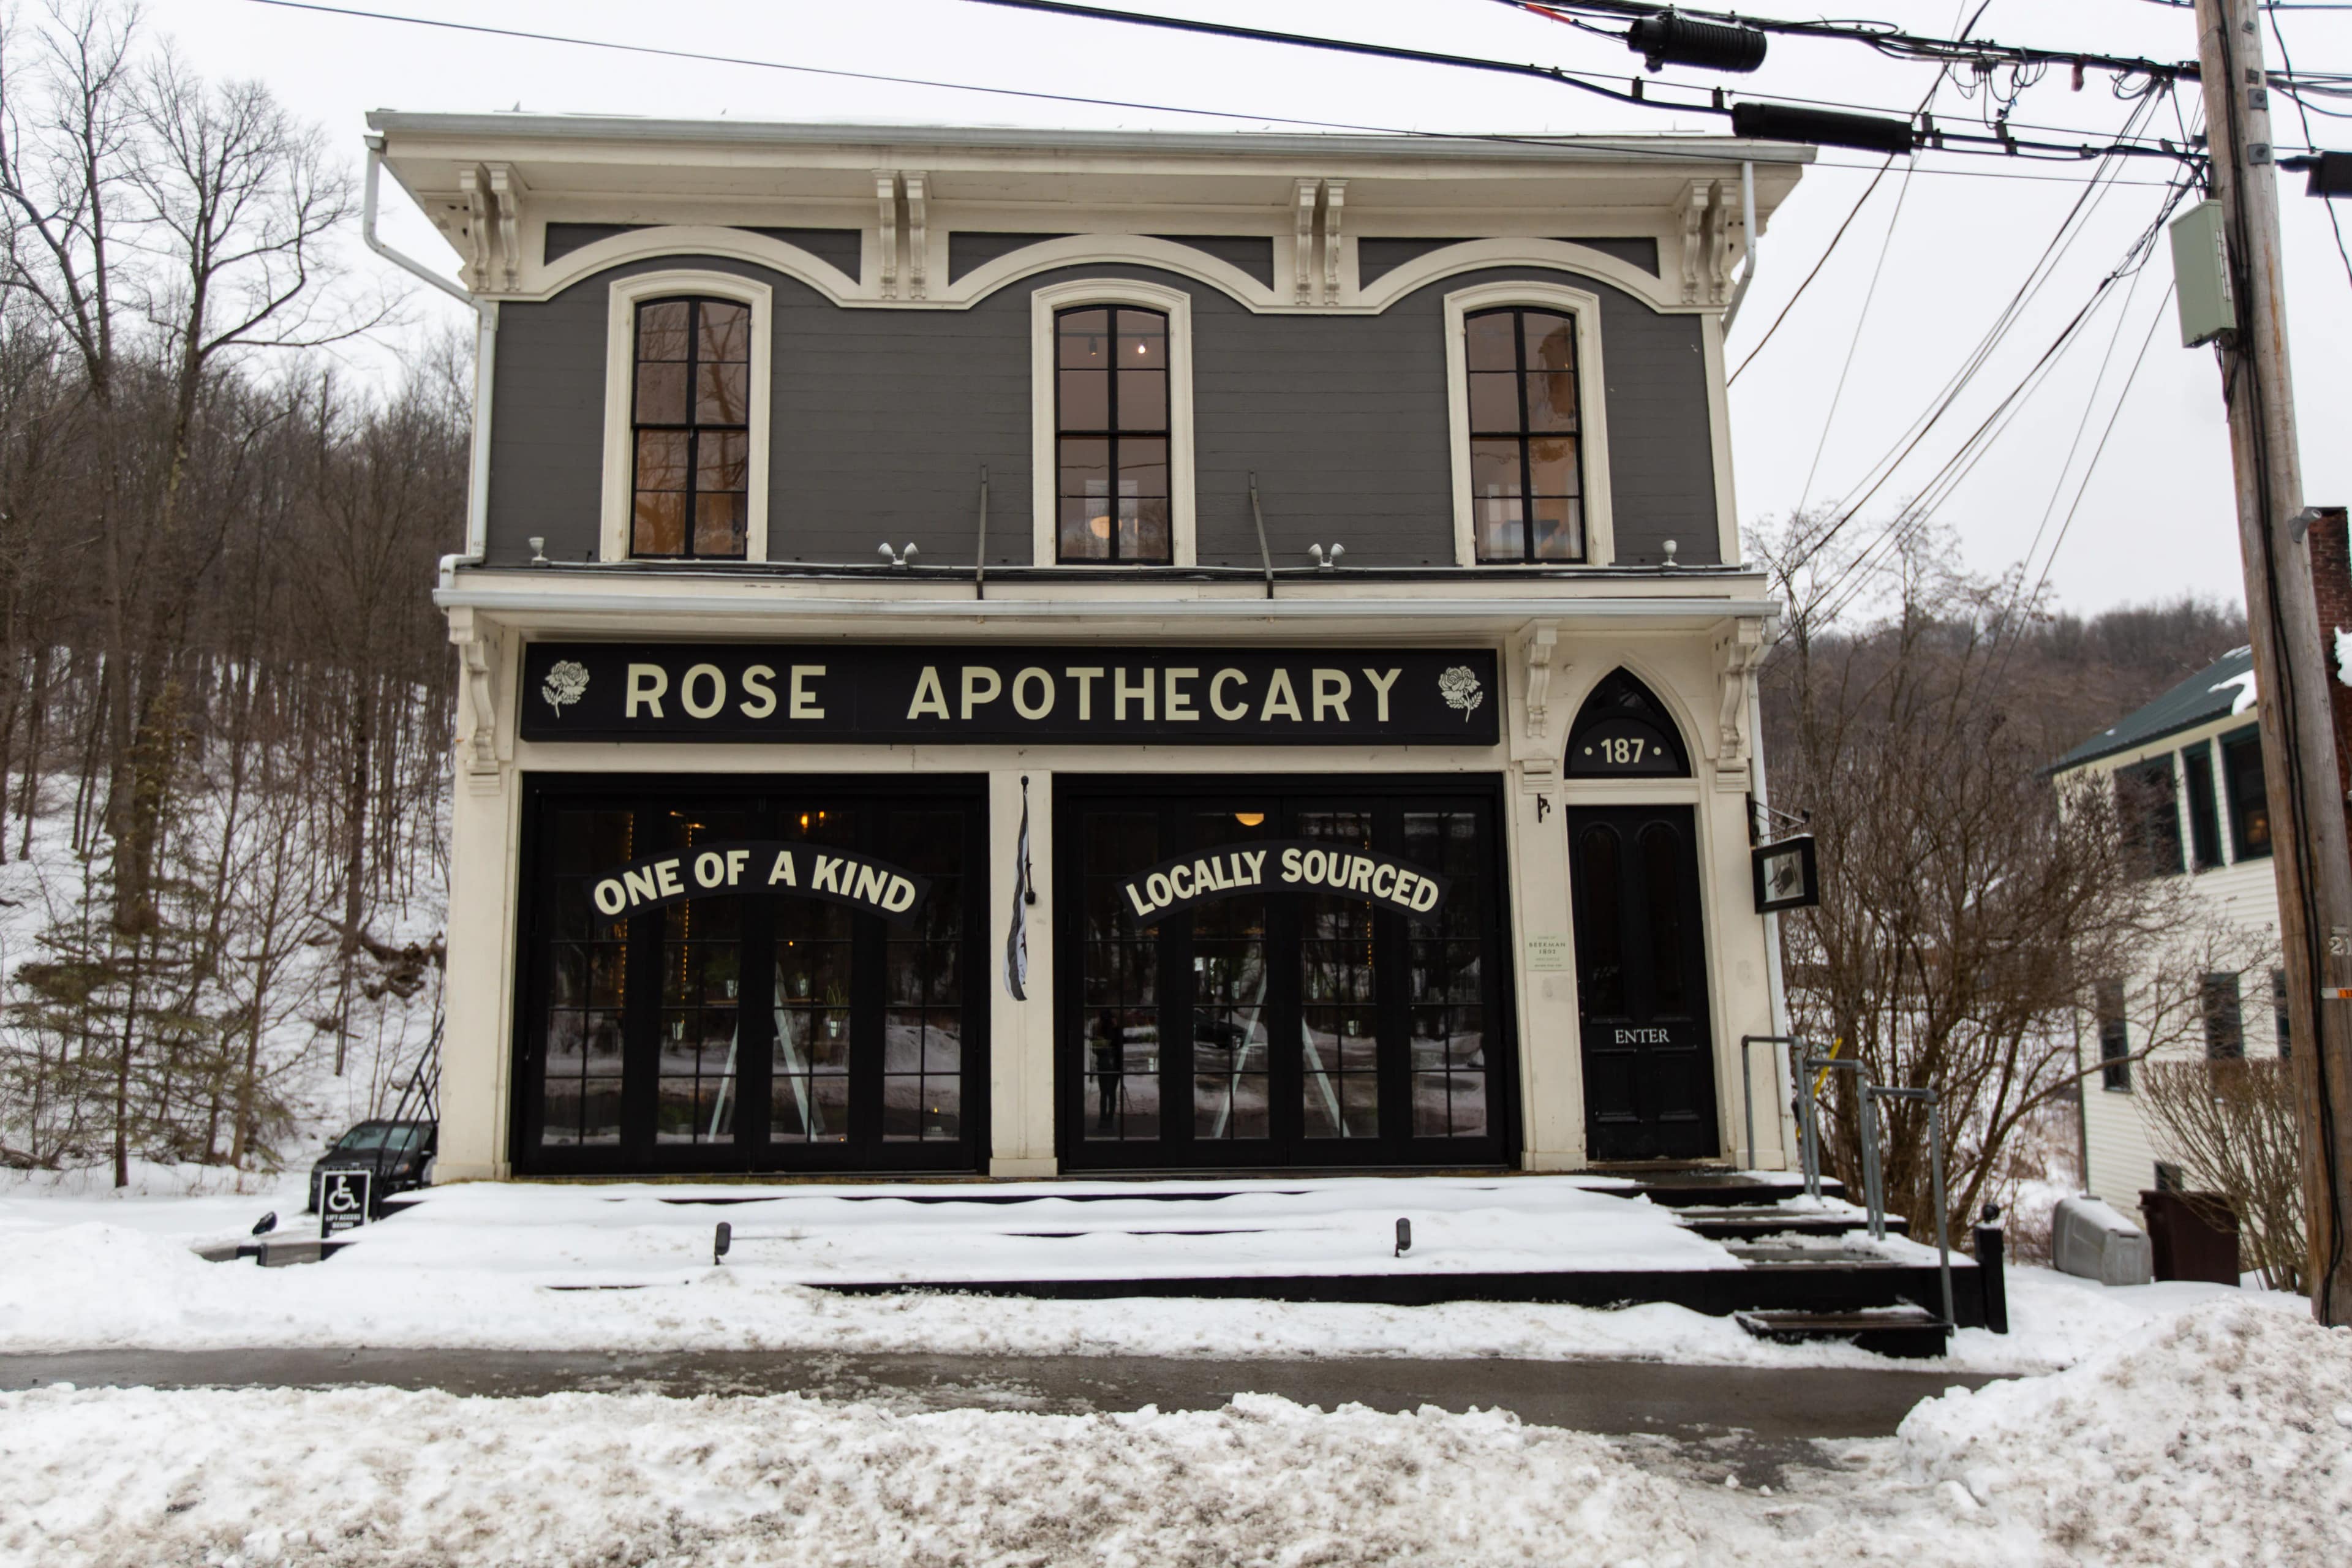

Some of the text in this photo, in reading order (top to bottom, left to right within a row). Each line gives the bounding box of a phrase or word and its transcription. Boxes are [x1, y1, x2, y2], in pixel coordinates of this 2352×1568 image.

[625, 663, 1402, 722] ROSE APOTHECARY
[1600, 738, 1645, 763] 187
[594, 850, 916, 915] ONE OF A KIND
[1125, 848, 1439, 916] LOCALLY SOURCED
[1615, 1028, 1670, 1044] ENTER
